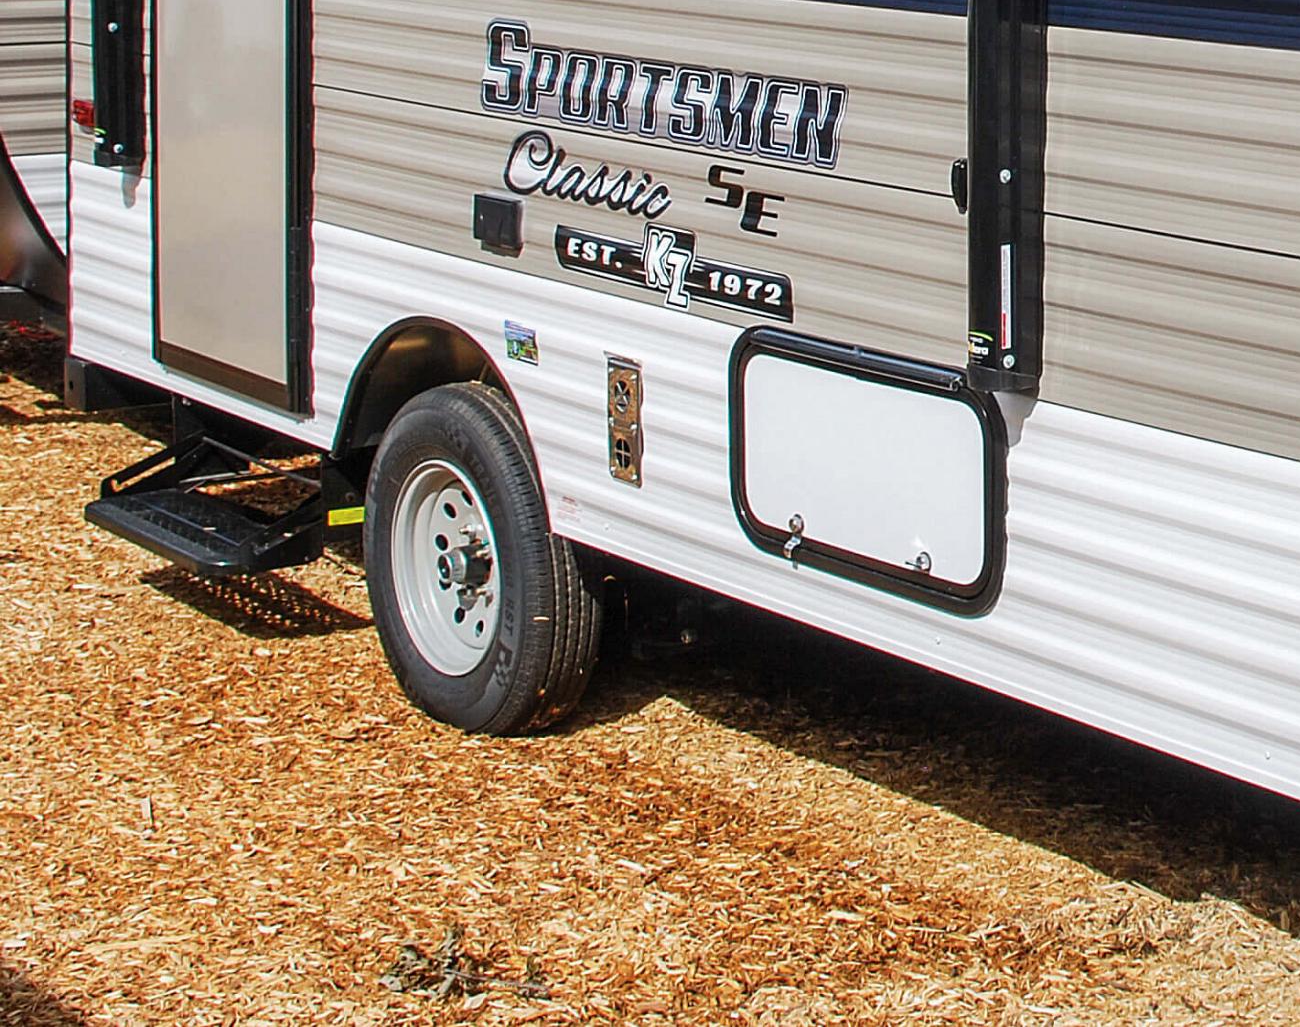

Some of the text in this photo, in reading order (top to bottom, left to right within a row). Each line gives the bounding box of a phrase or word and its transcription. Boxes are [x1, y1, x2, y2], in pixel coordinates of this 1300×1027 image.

[504, 130, 785, 237] Classic SE
[567, 236, 623, 269] EST.
[708, 270, 783, 307] 1972
